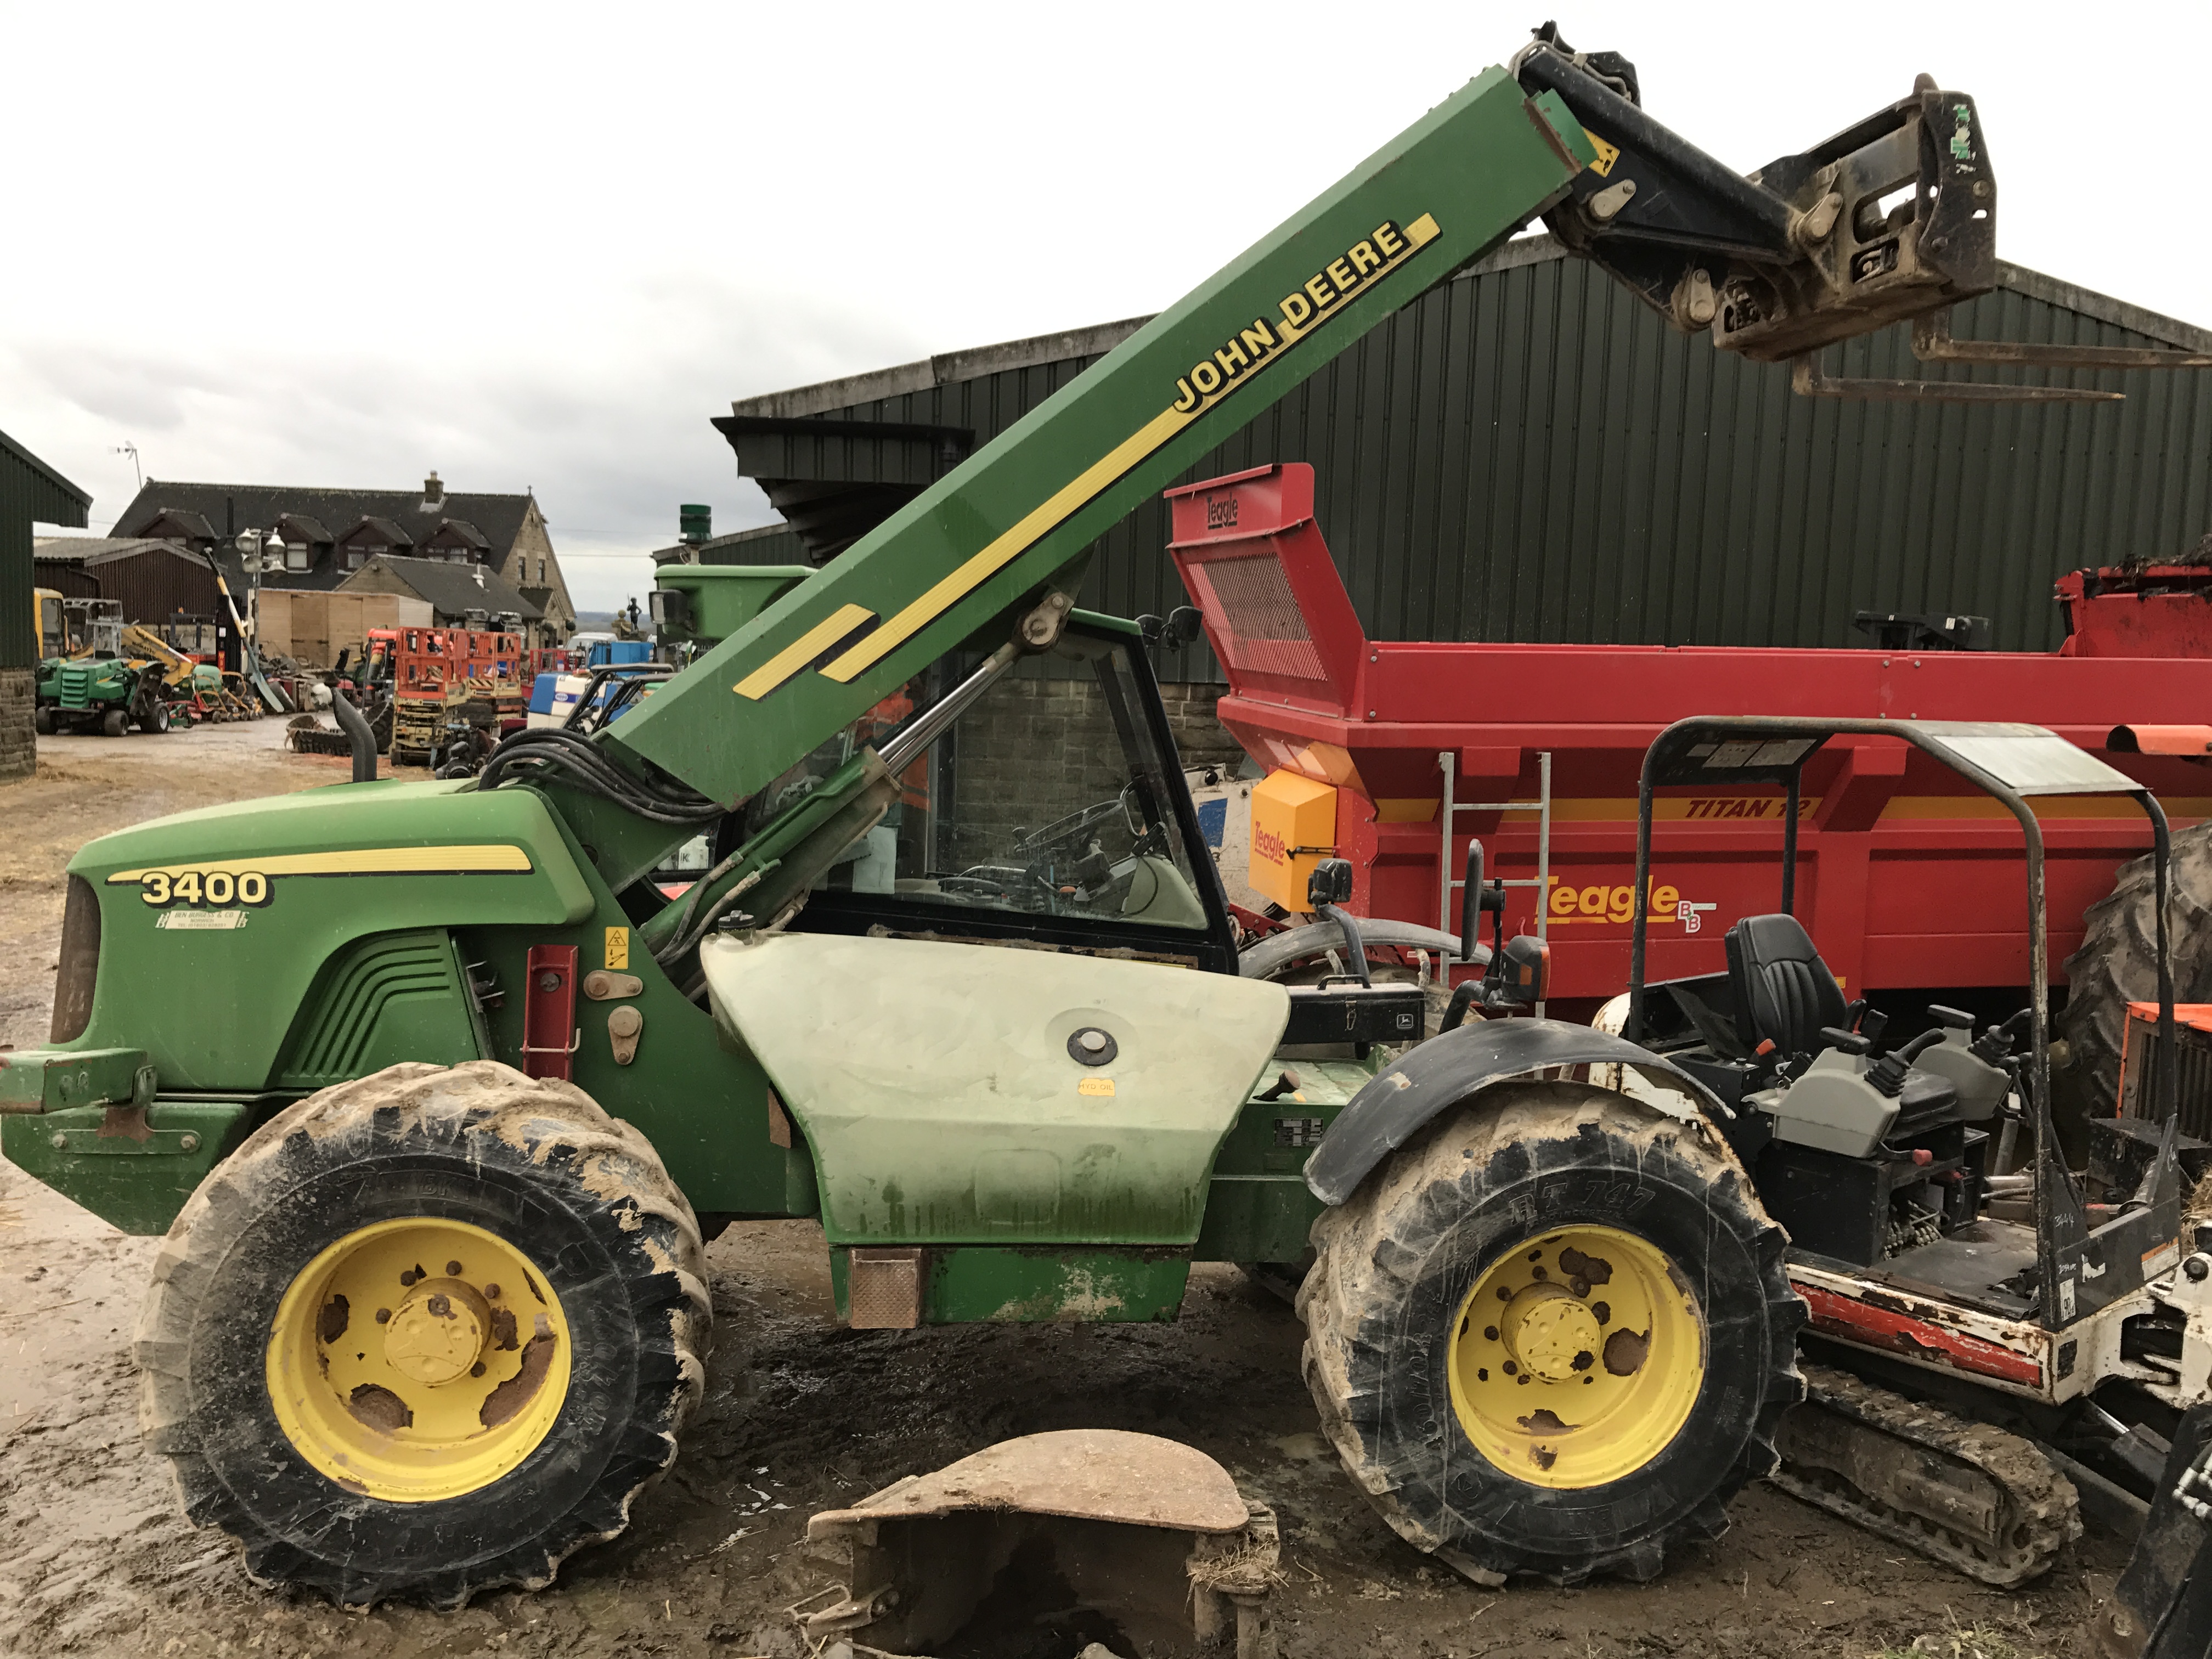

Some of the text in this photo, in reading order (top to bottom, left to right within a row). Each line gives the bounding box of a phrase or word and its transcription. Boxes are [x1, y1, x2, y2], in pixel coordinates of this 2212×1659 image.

[1172, 221, 1404, 413] JOHN DEERE
[1207, 492, 1238, 528] Teagle
[1685, 799, 1773, 817] TITAN
[1255, 820, 1285, 861] Teagle
[140, 871, 271, 907] 3400
[1581, 1180, 1656, 1212] 747
